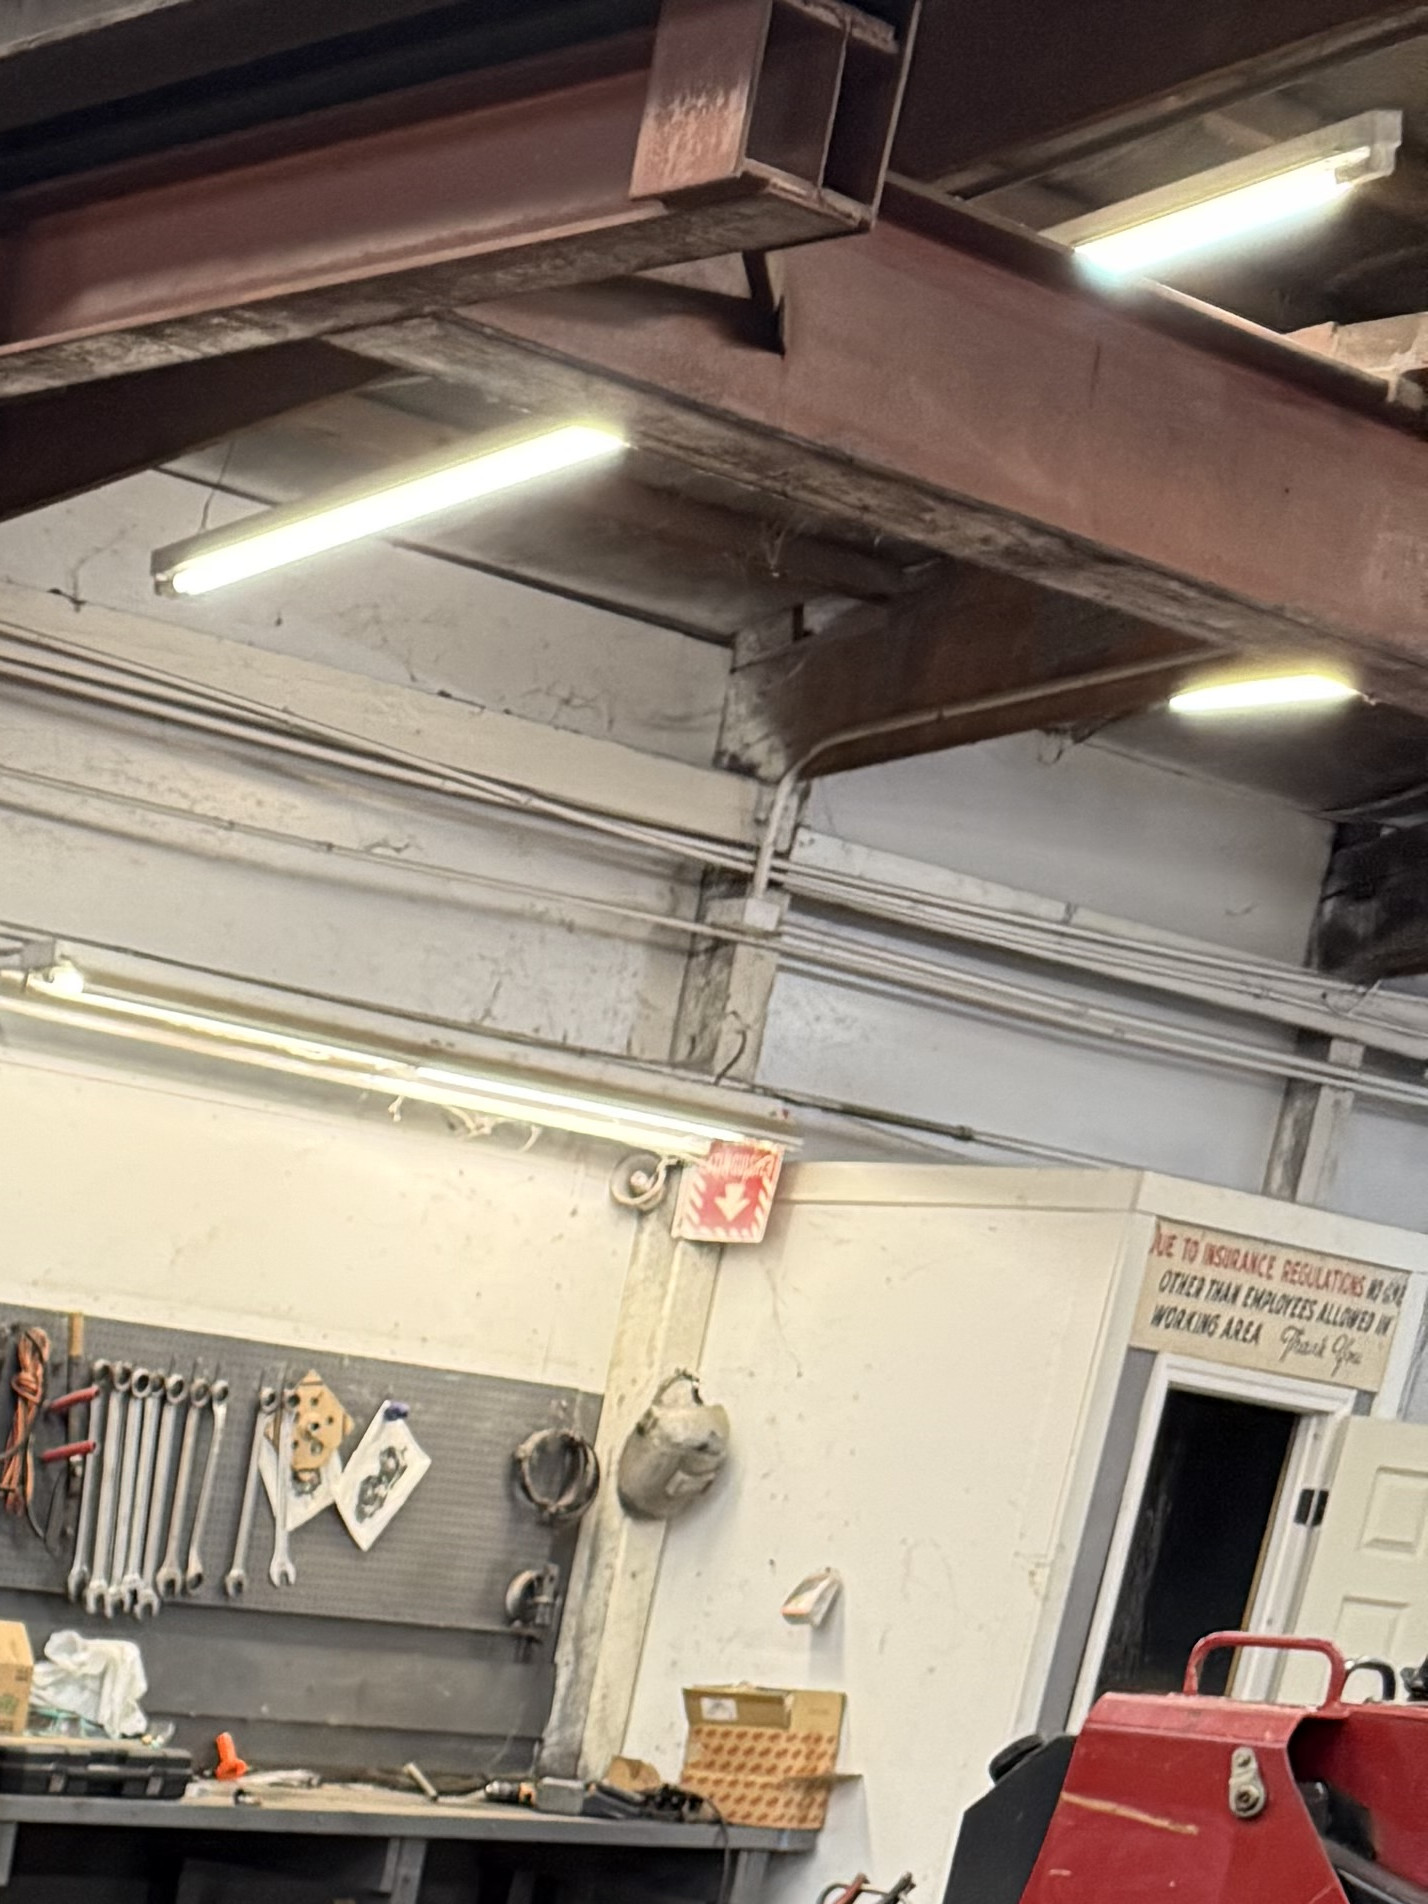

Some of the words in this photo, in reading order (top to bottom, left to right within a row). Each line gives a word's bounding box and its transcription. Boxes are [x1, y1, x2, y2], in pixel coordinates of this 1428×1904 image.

[1181, 1237, 1200, 1262] TO
[1203, 1242, 1276, 1282] INSURANCE
[1281, 1259, 1367, 1298] REGULATIONS
[1150, 1304, 1218, 1342] WORKING
[1219, 1315, 1265, 1346] AREA
[1158, 1269, 1205, 1299] OTHER
[1205, 1280, 1241, 1306] THAN
[1241, 1286, 1317, 1322] EMPLOYEES
[1316, 1301, 1376, 1333] ALLOWED
[1374, 1313, 1394, 1337] IN
